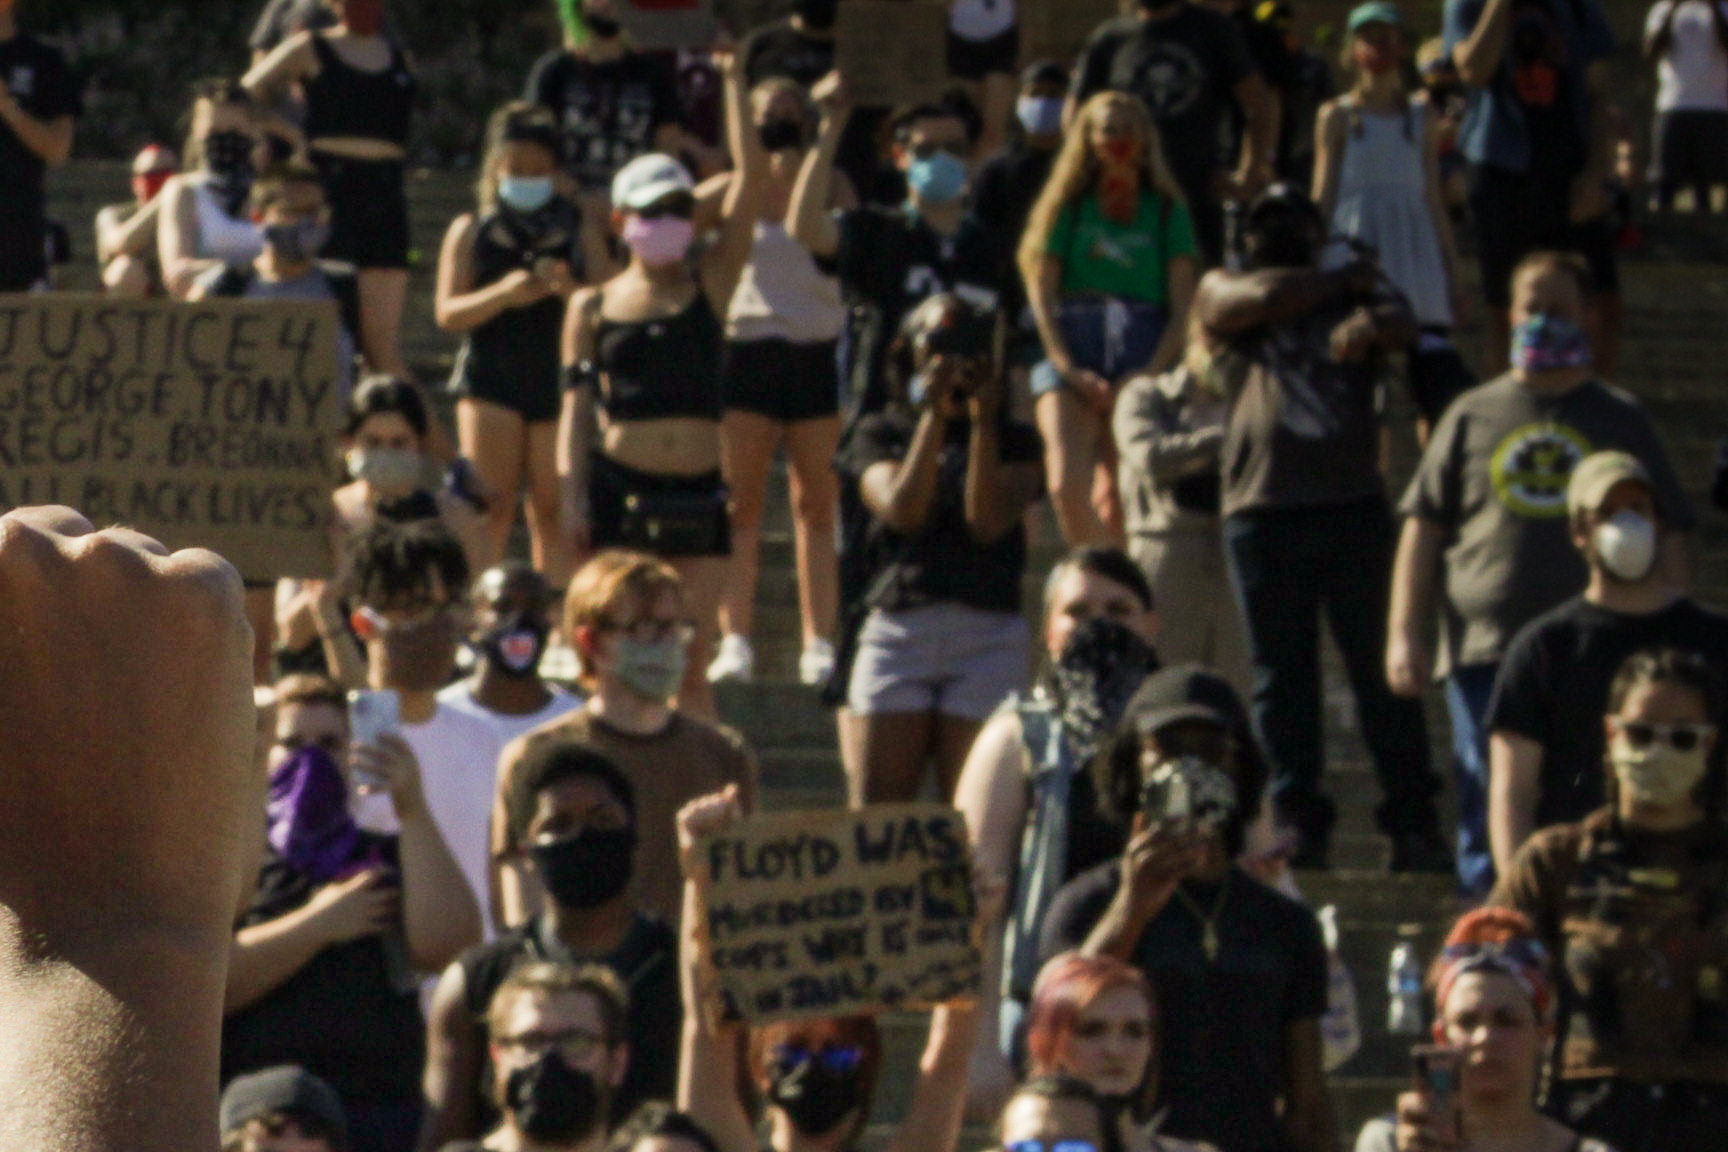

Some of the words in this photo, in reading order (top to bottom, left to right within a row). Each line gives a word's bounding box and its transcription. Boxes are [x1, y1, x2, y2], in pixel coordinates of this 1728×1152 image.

[278, 316, 318, 384] 4
[199, 373, 329, 429] TONY
[208, 483, 319, 530] LIVES
[709, 833, 841, 882] FLOYD
[854, 817, 963, 864] WAS
